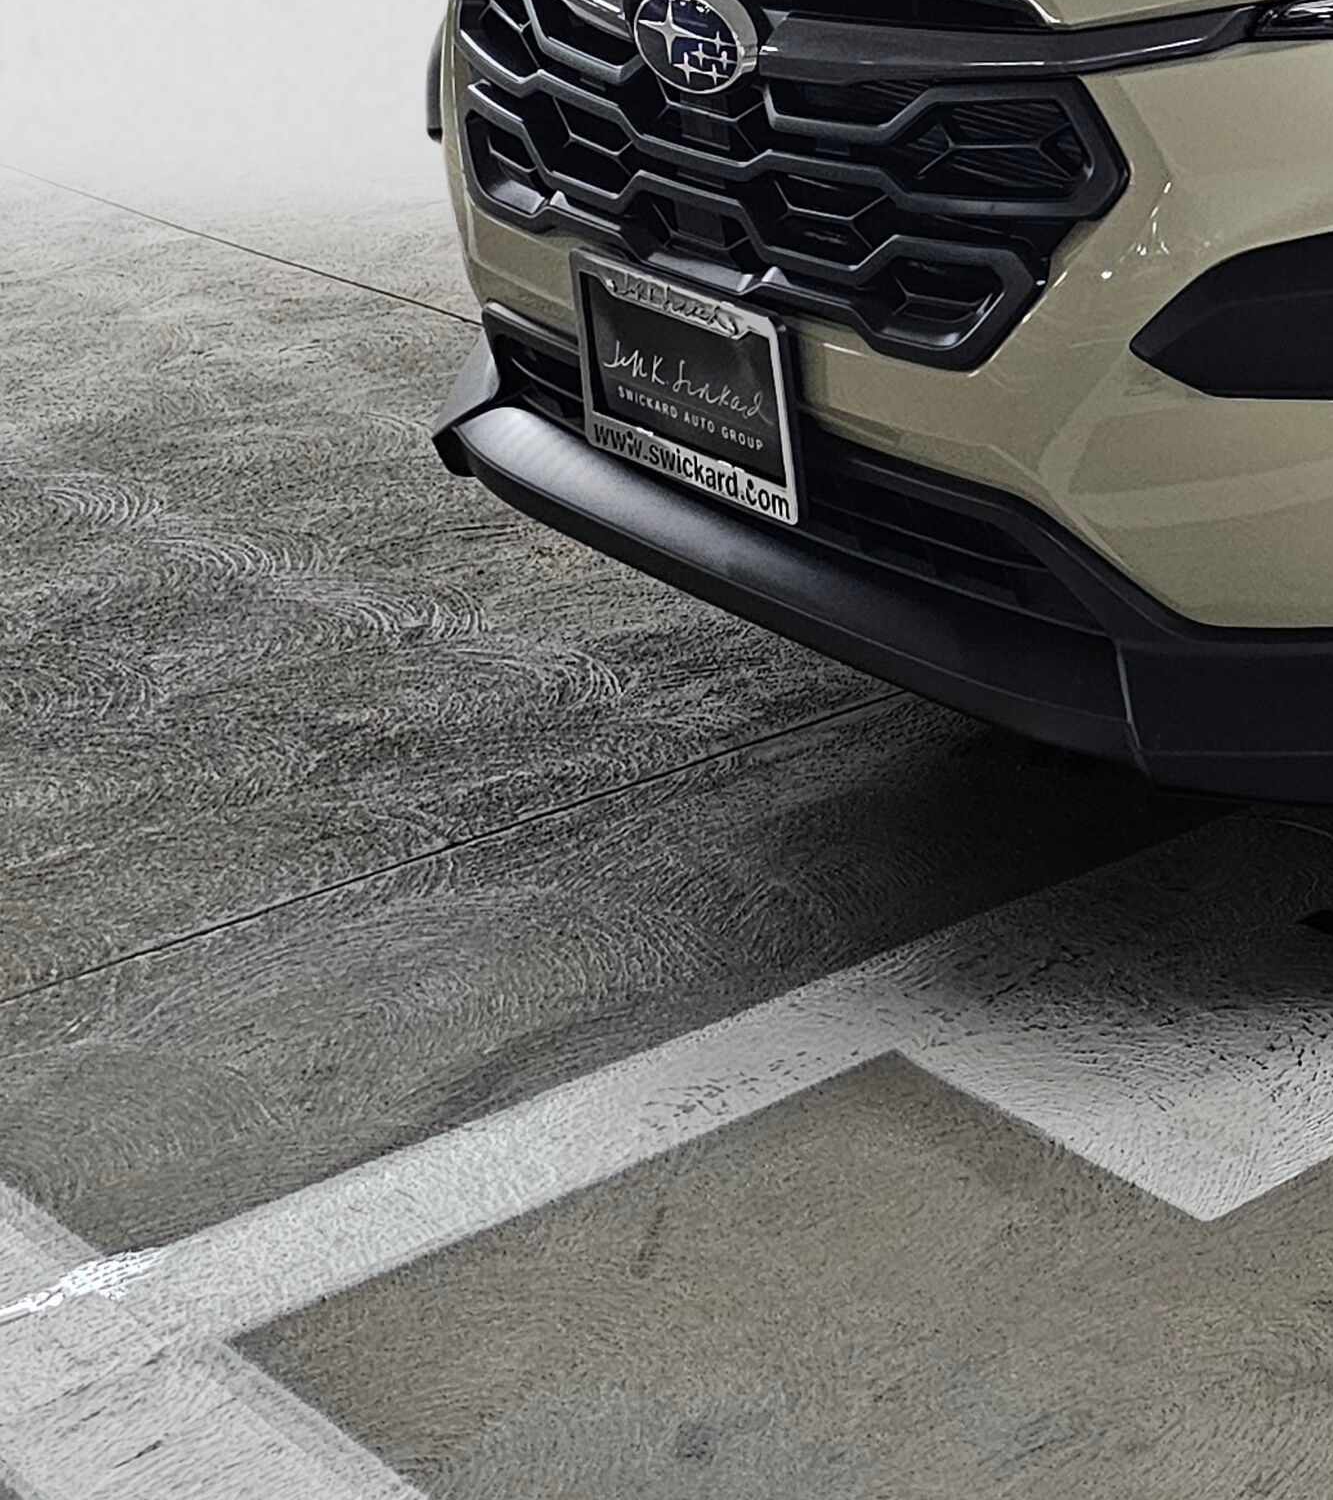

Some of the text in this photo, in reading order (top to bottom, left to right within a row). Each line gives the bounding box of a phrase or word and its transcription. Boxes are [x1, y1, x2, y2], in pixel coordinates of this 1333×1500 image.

[617, 385, 764, 451] SWICKARD AUTO GROUP
[593, 423, 791, 521] www.swickard.com
